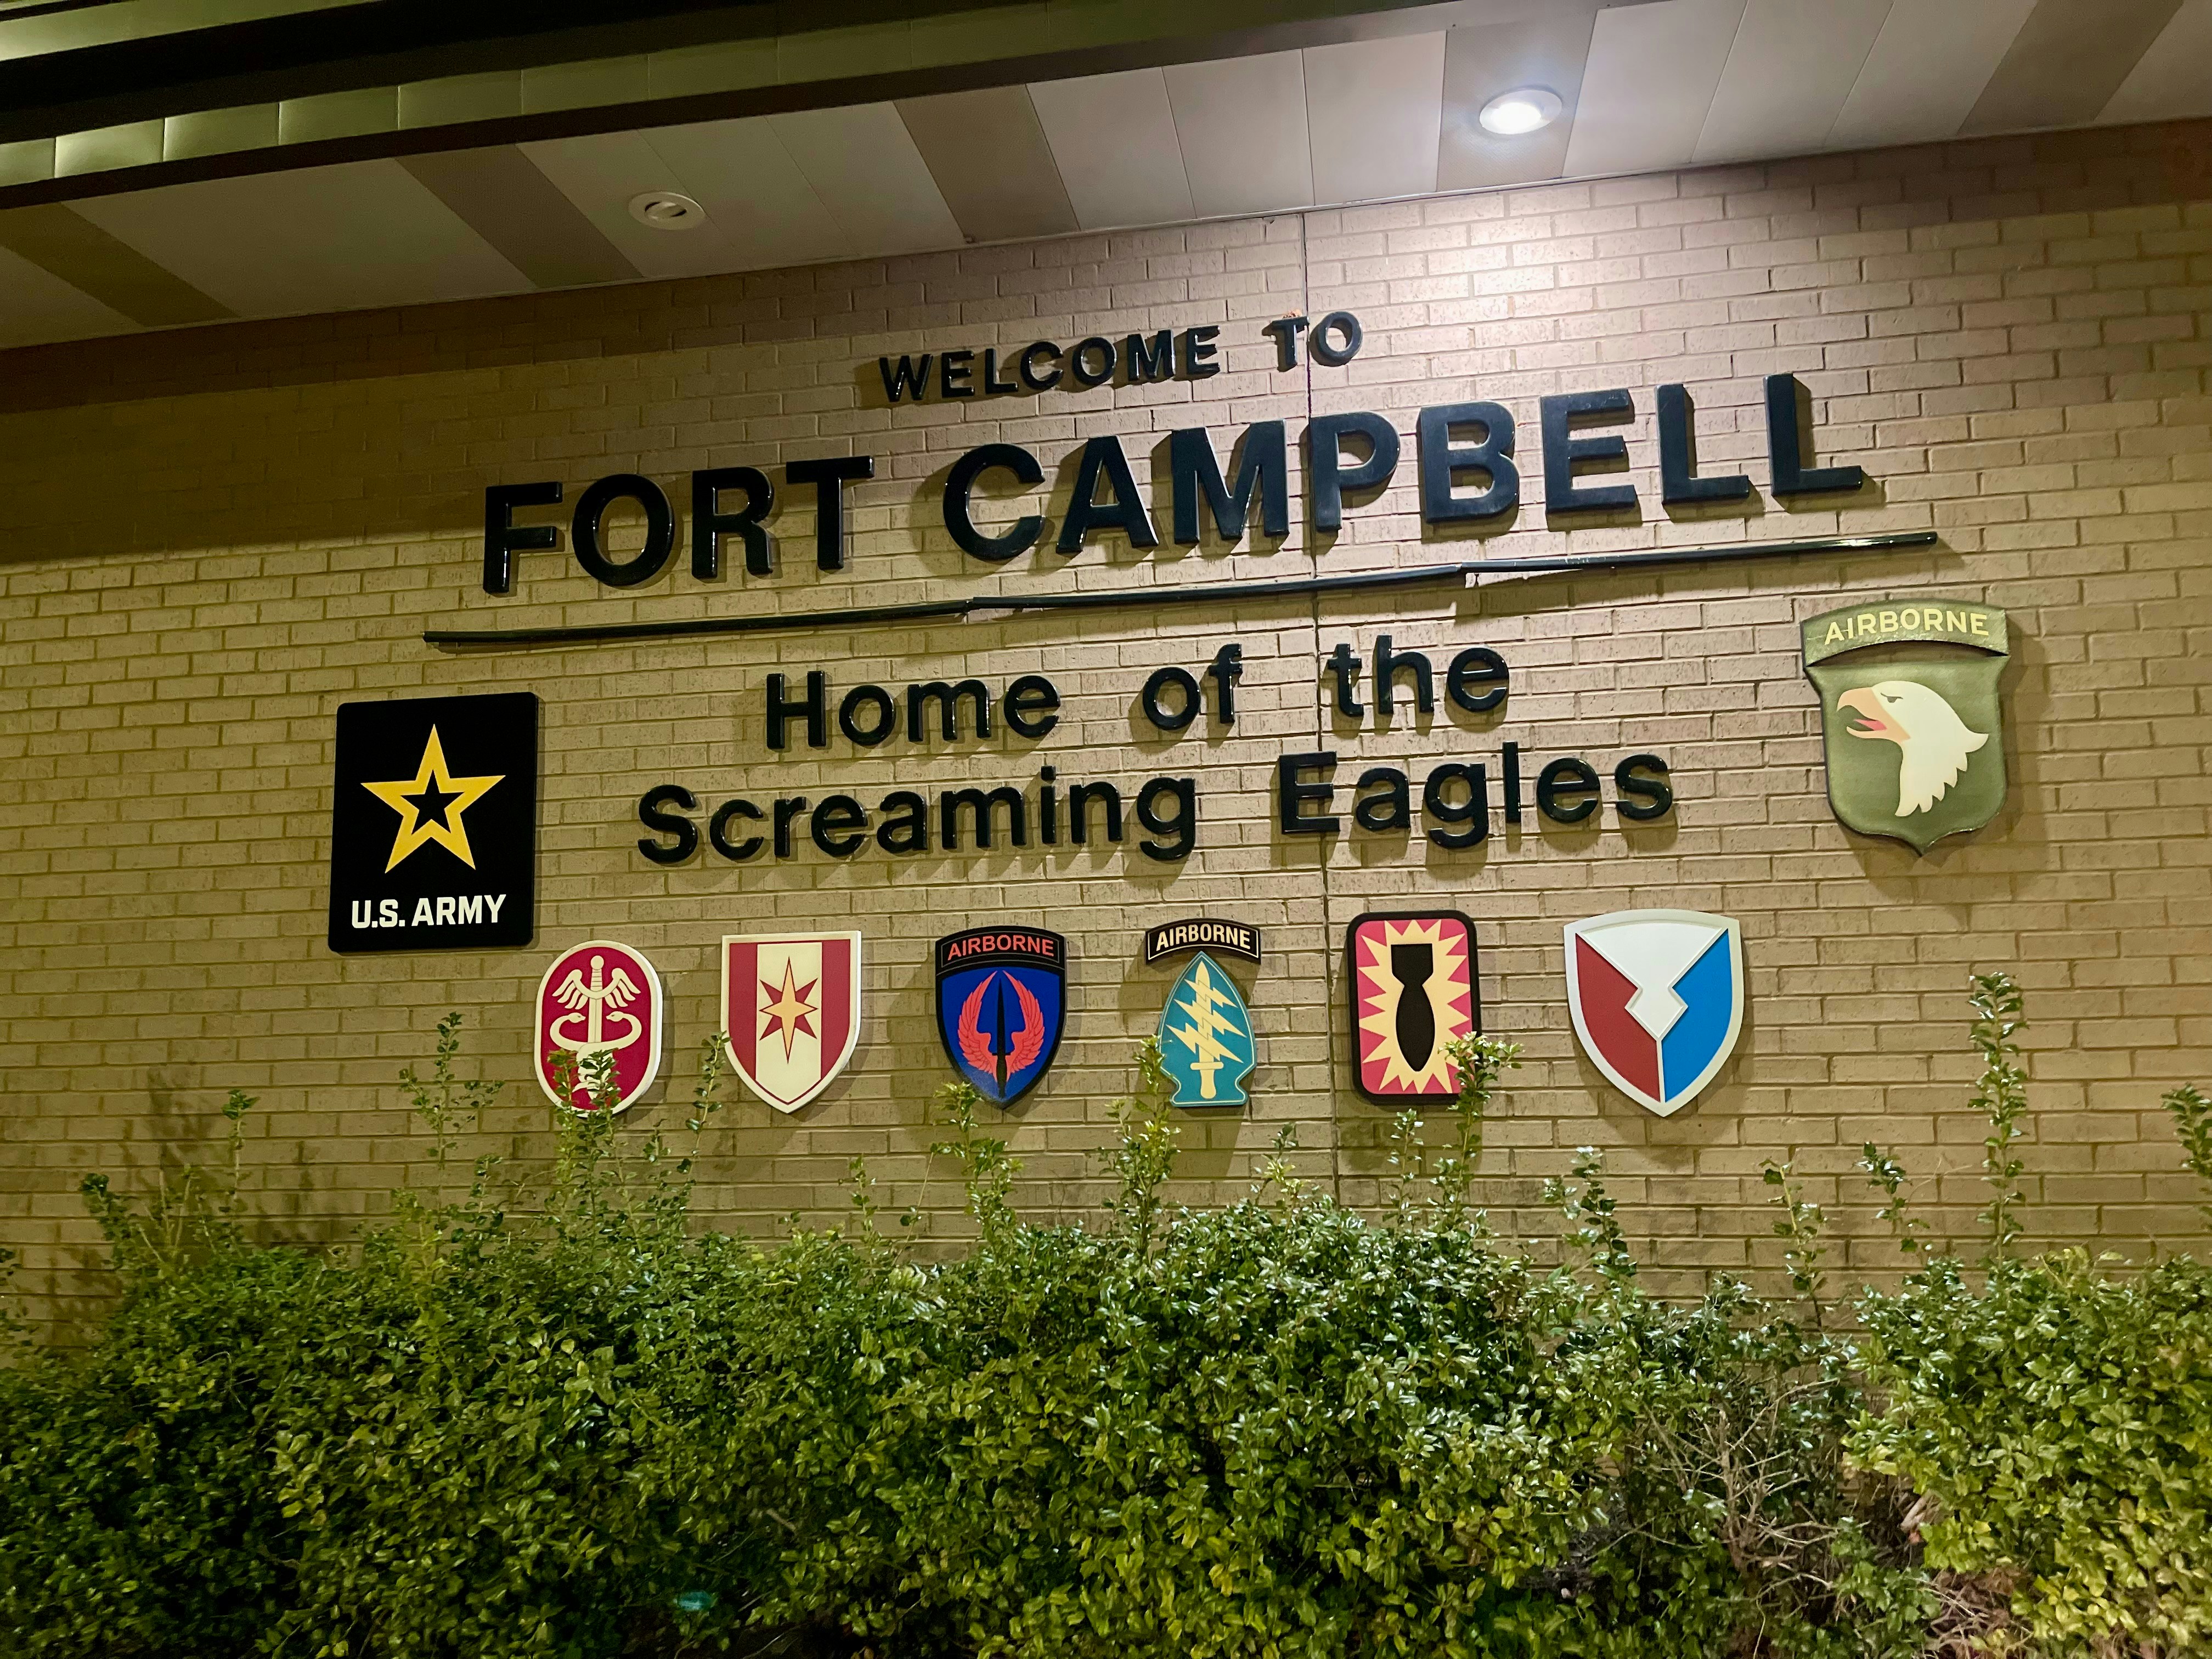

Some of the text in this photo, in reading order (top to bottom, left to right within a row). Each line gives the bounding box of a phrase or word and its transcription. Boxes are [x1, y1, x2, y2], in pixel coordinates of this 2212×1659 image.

[880, 311, 1363, 402] WELCOME TO
[483, 373, 1862, 594] FORT CAMPBELL
[1825, 608, 1989, 645] AIRBORNE
[768, 635, 1509, 748] Home of the
[637, 741, 1673, 863] Screaming Eagles
[352, 894, 506, 928] U.S. ARMY
[1156, 924, 1250, 951] AIRBORNE
[948, 935, 1054, 960] AIRBORNE
